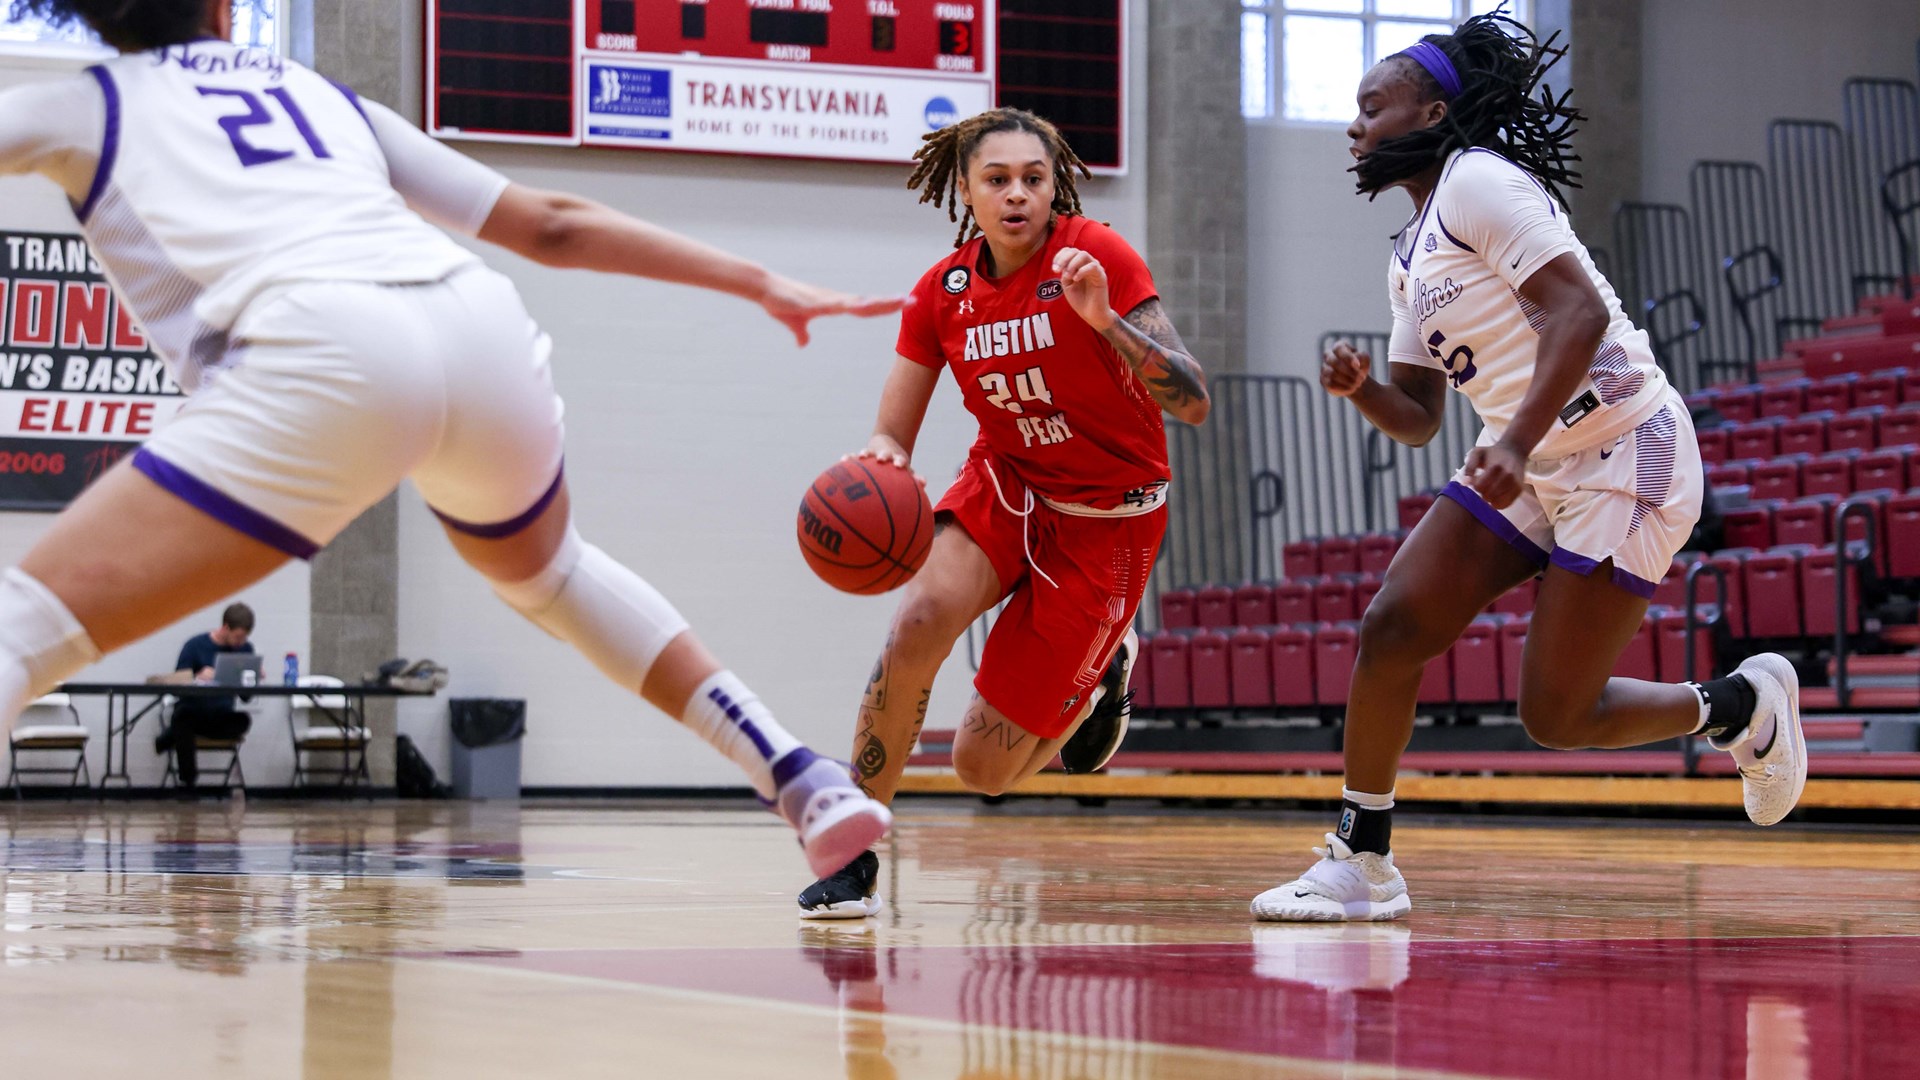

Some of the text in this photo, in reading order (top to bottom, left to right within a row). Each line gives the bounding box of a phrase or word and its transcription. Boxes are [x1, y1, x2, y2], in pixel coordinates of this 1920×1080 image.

[935, 4, 974, 20] FOULS
[596, 33, 638, 50] SCORE
[952, 21, 969, 53] 3
[767, 44, 811, 61] MATCH
[936, 55, 975, 71] SCORE
[686, 80, 890, 117] TRANSYLVANIA
[195, 86, 334, 167] 21
[686, 119, 890, 144] HOME OF THE PIONEERS
[1041, 284, 1059, 296] OVC
[963, 311, 1056, 362] AUSTIN
[977, 366, 1053, 414] 24
[18, 398, 156, 435] ELITE
[1016, 412, 1074, 448] PEAY
[0, 451, 66, 475] 2006
